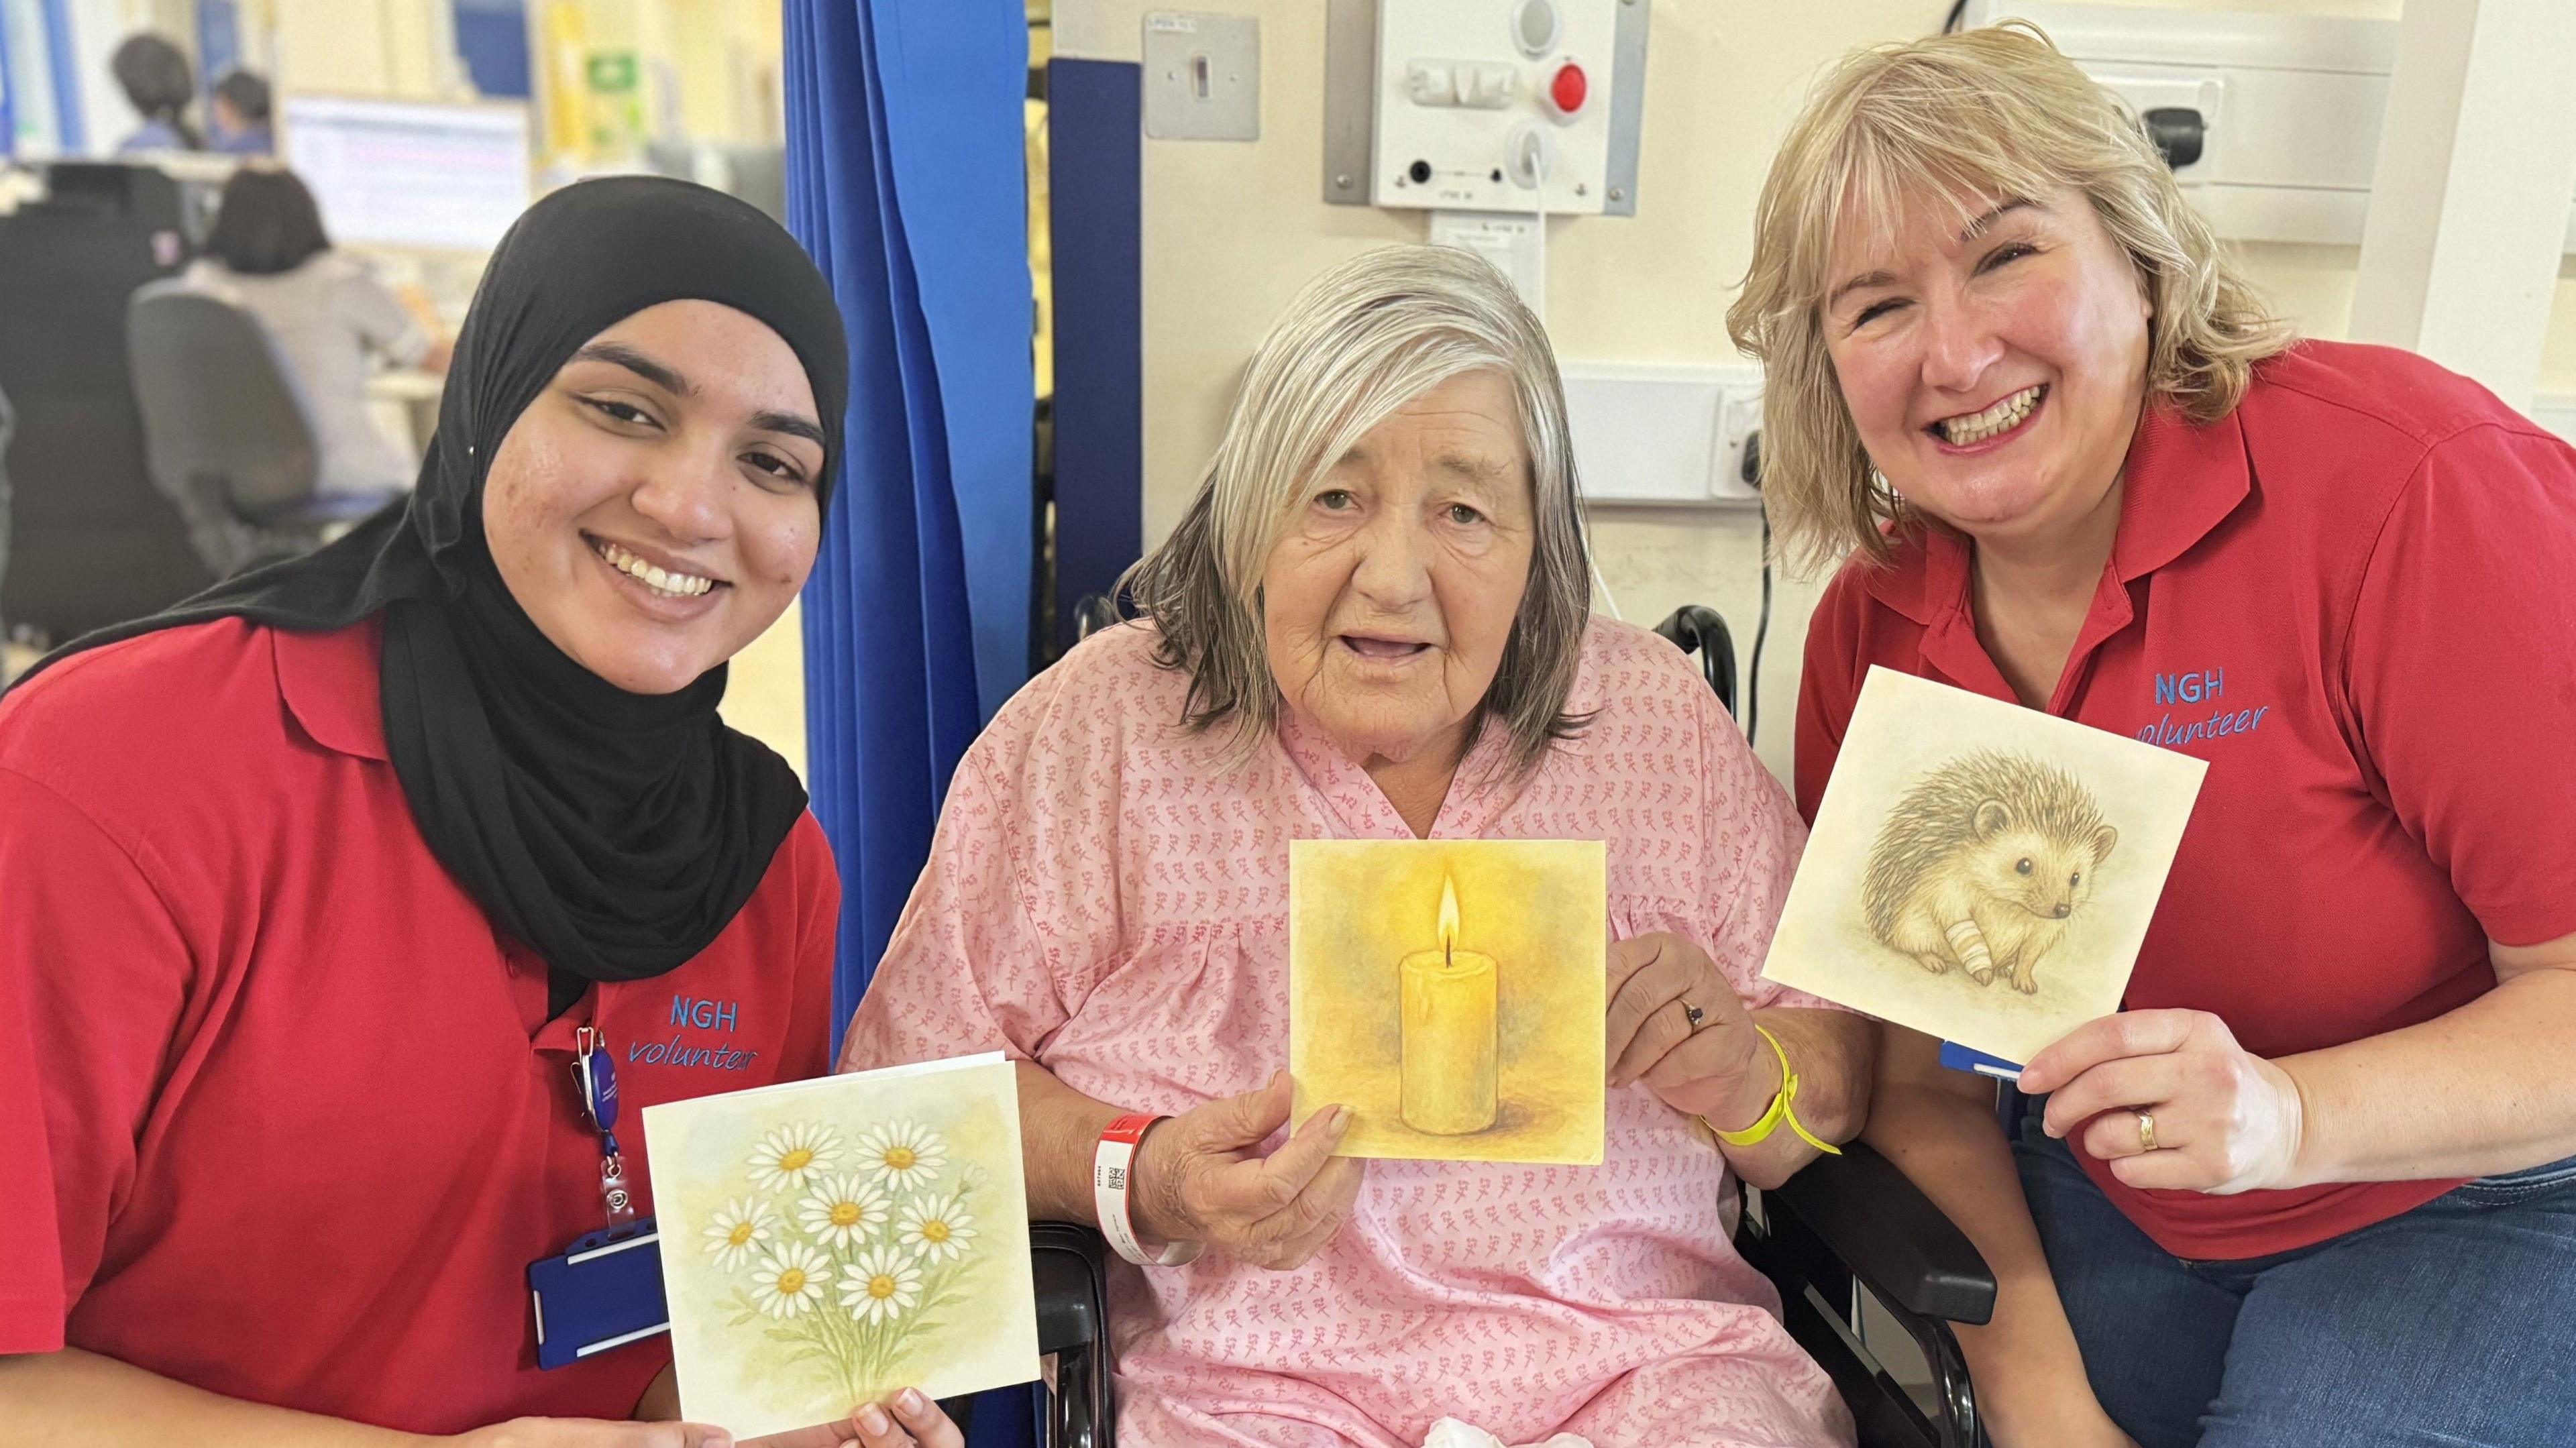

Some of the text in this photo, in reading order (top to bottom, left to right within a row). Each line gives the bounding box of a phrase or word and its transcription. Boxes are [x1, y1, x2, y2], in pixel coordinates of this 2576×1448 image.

[2155, 667, 2224, 705] NGH
[2135, 706, 2269, 746] olunteer
[671, 994, 737, 1032] NGH
